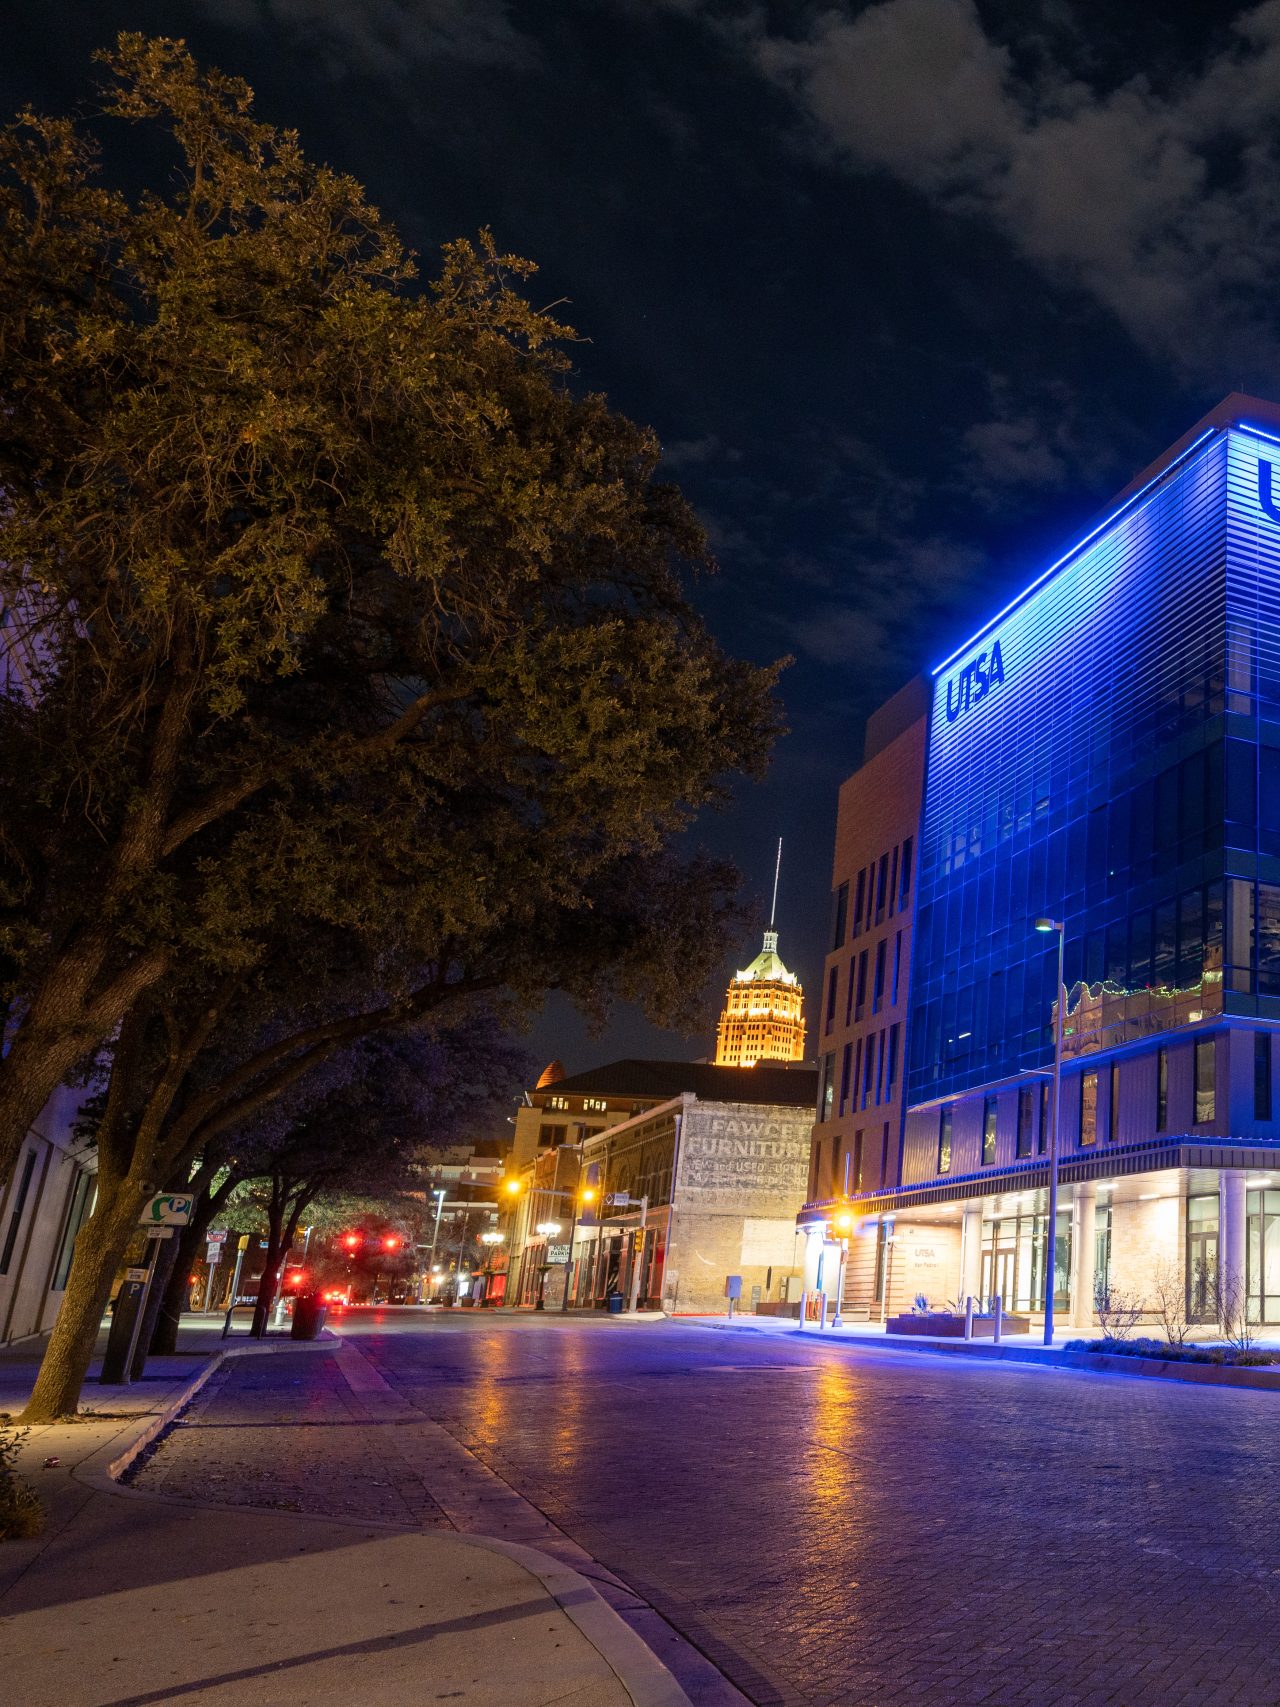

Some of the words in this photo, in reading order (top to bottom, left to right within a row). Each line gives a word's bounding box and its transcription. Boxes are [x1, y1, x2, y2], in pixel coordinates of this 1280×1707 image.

[946, 640, 1005, 723] UTSA
[736, 1162, 765, 1173] USED
[172, 1199, 186, 1212] P
[915, 1248, 936, 1257] UTSA
